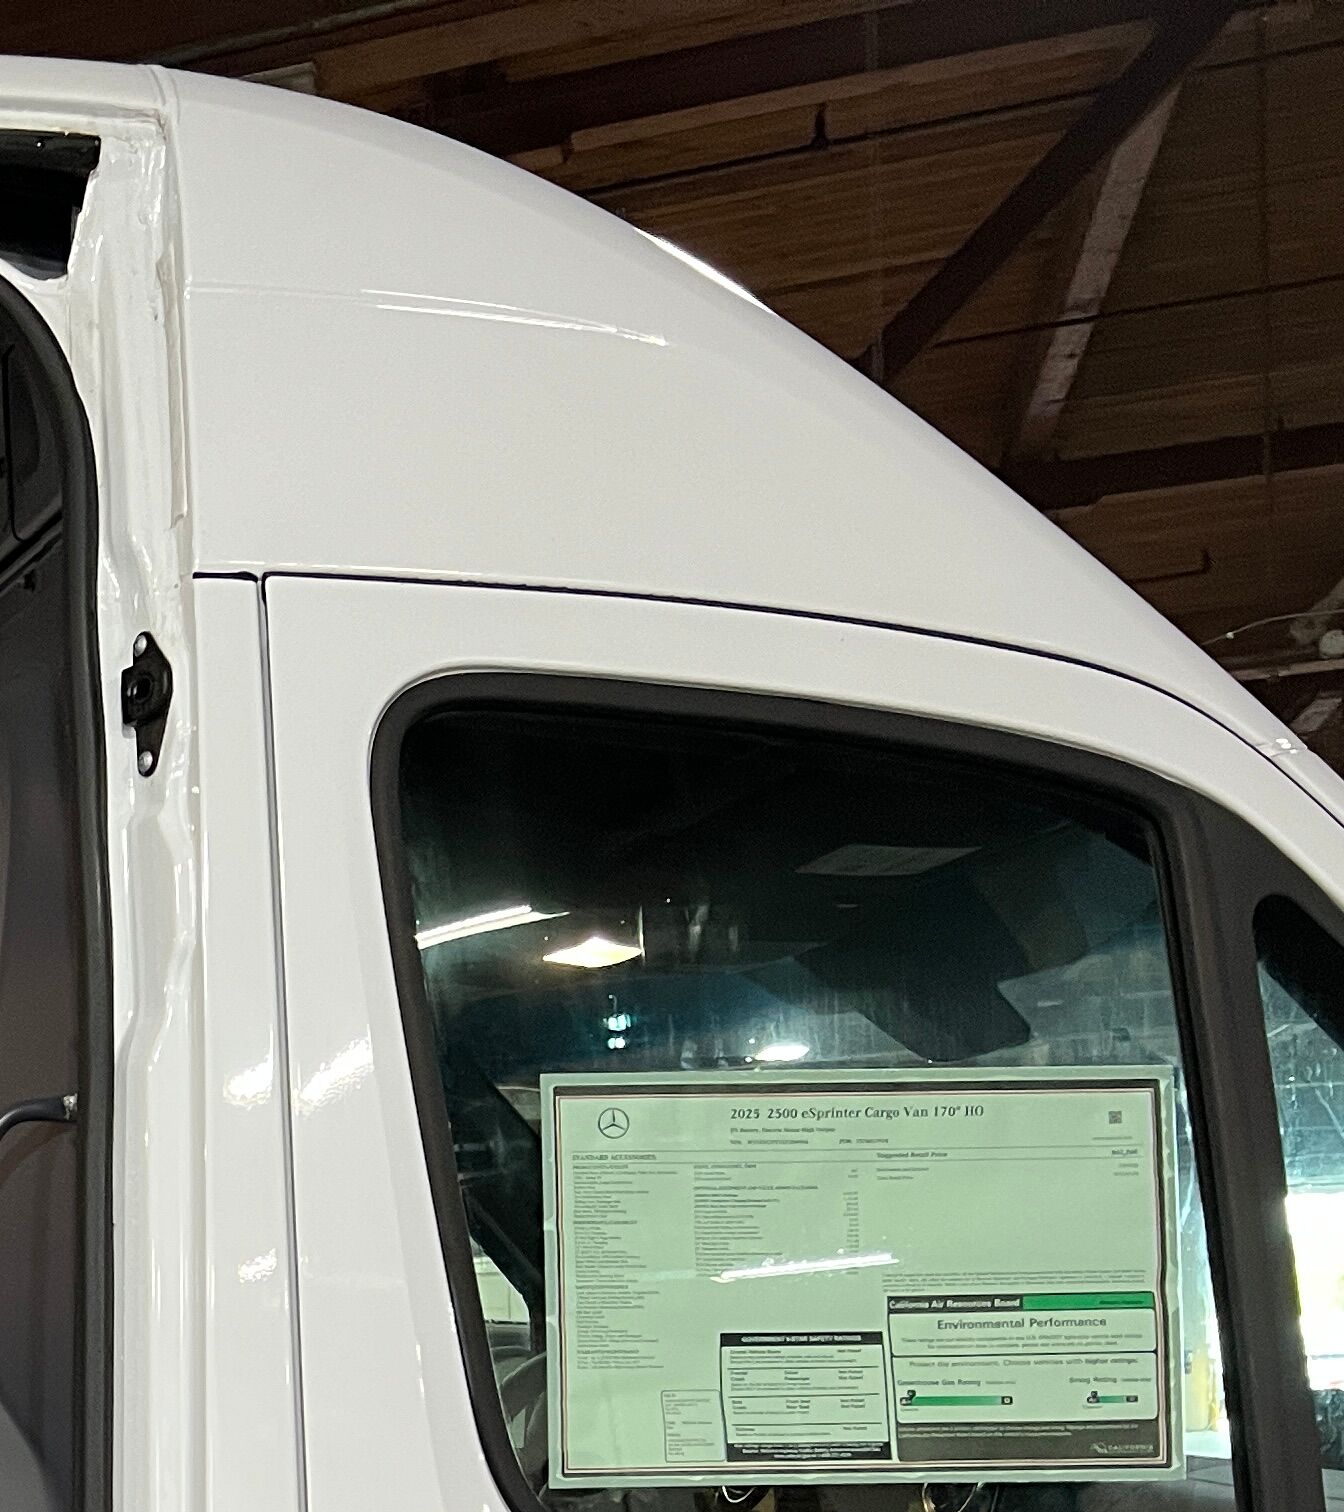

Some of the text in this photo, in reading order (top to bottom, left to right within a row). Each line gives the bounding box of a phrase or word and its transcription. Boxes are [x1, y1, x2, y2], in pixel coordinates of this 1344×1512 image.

[730, 1108, 760, 1119] 2025
[767, 1108, 798, 1119] 2500
[801, 1107, 862, 1121] eSprinter
[864, 1106, 900, 1120] Cargo
[903, 1106, 929, 1117] Van
[888, 1300, 930, 1309] California
[931, 1300, 946, 1308] Air
[937, 1317, 1107, 1330] Environmental Performance
